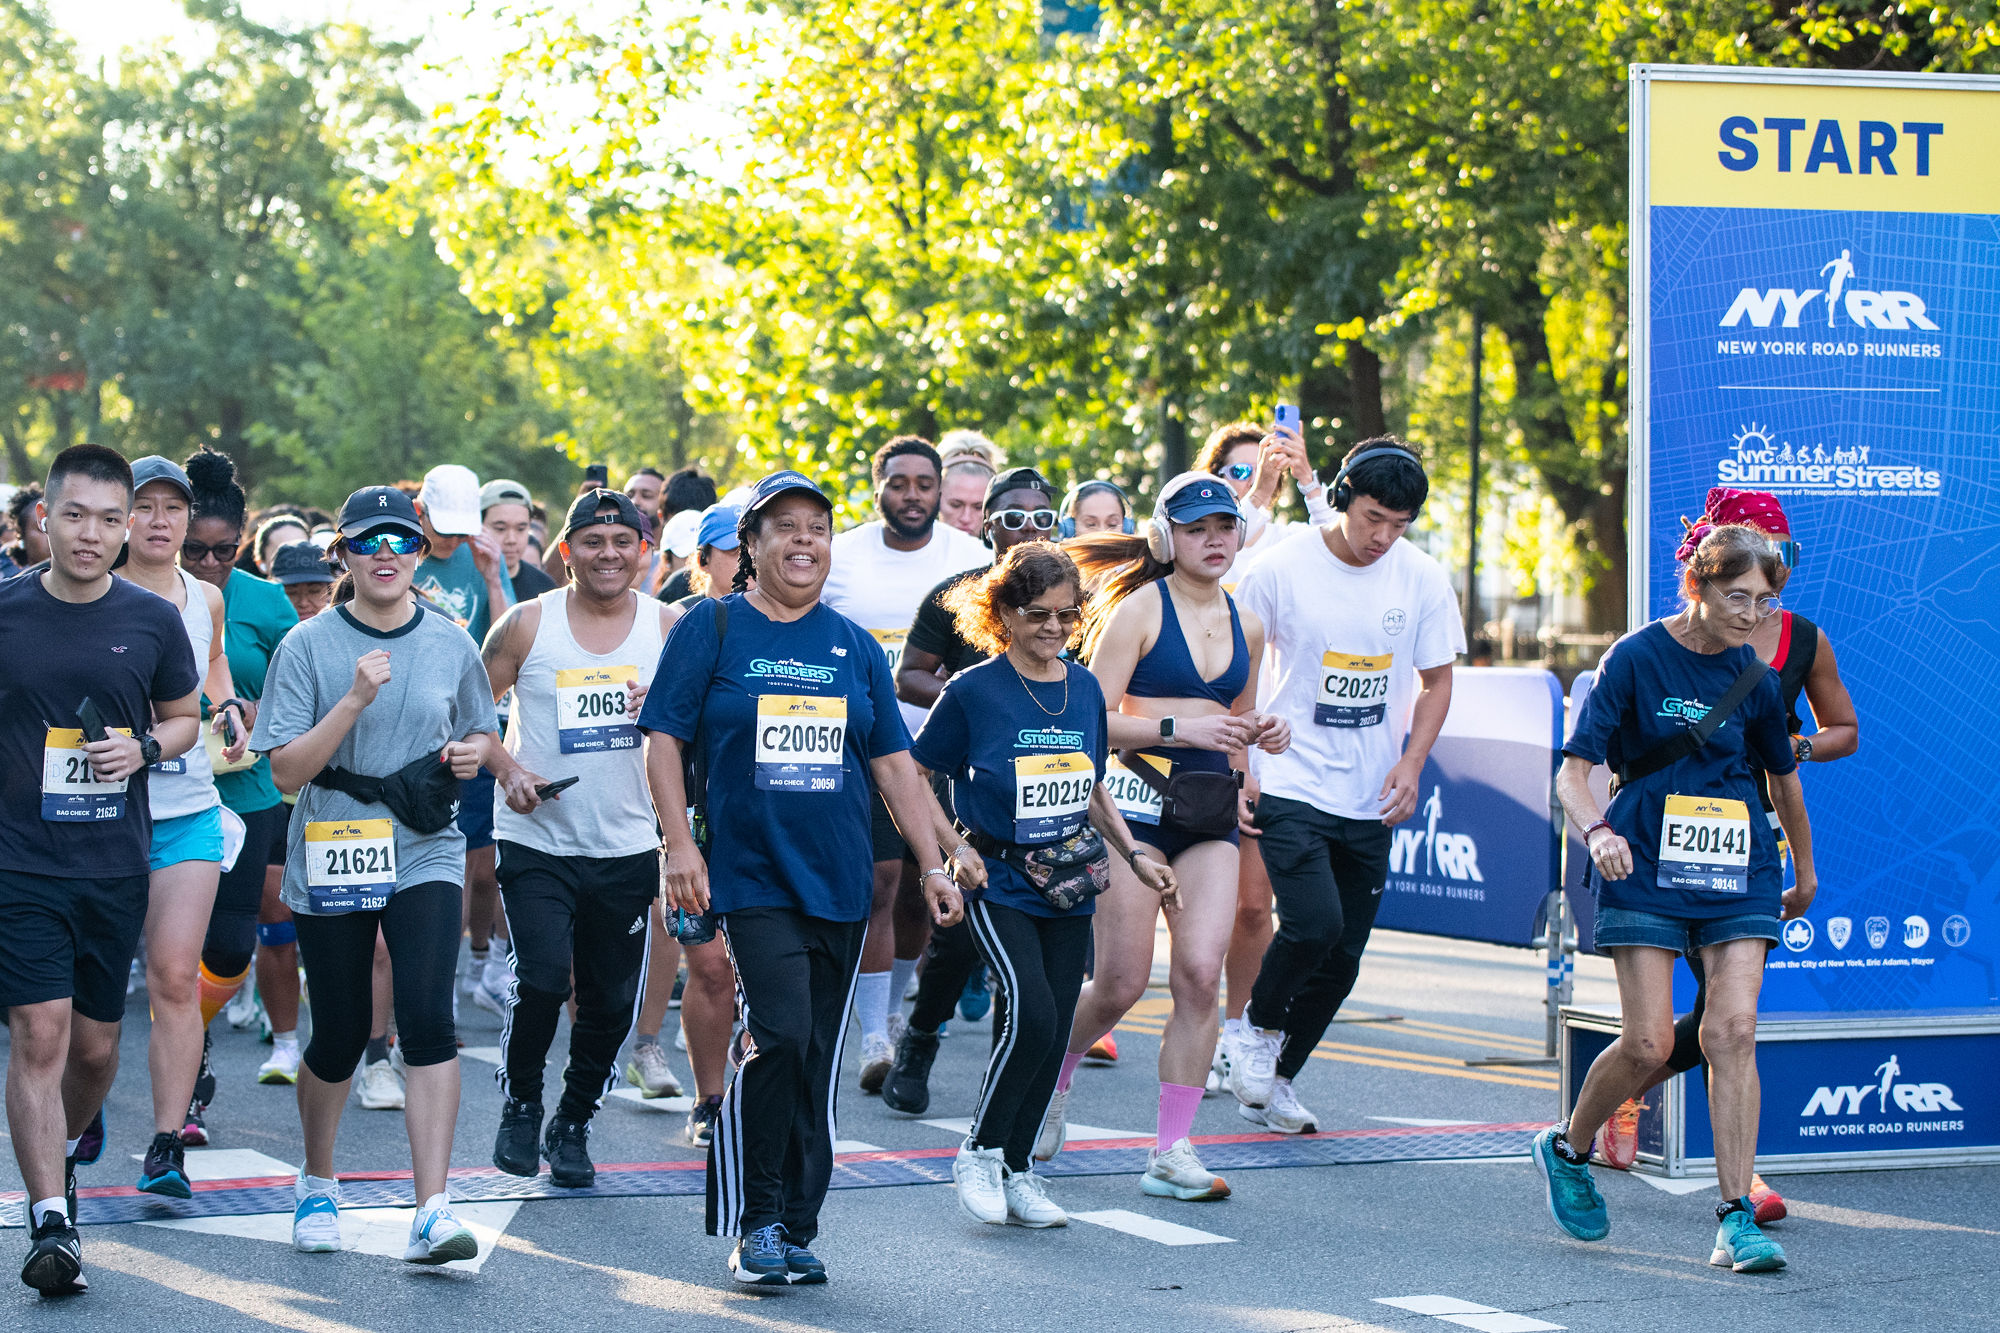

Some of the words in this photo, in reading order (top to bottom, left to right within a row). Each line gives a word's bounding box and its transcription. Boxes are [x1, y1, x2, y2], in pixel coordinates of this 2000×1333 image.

[1718, 116, 1943, 176] START
[1717, 341, 1757, 355] NEW
[1761, 341, 1806, 355] YORK
[1812, 342, 1858, 356] ROAD
[1864, 343, 1941, 357] RUNNERS
[1738, 450, 1774, 464] NYC
[1804, 488, 1857, 498] Transportation
[1859, 489, 1879, 498] Open
[1880, 489, 1908, 498] Streets
[757, 663, 827, 679] STRIDERS
[1324, 674, 1388, 699] C20273
[577, 691, 626, 718] 2063
[1359, 715, 1377, 726] 20273
[610, 736, 634, 748] 20633
[762, 724, 841, 753] C20050
[1024, 734, 1079, 745] STRIDERS
[161, 761, 180, 771] 21619
[811, 777, 835, 790] 20050
[1023, 778, 1092, 808] E20219
[96, 807, 117, 818] 21623
[1668, 823, 1746, 855] E20141
[326, 846, 392, 875] 21621
[1395, 881, 1416, 893] YORK
[1420, 883, 1442, 896] ROAD
[1446, 886, 1485, 902] RUNNERS
[1712, 877, 1738, 891] 20141
[361, 896, 387, 909] 21621
[1769, 960, 1786, 969] with
[1787, 960, 1800, 969] the
[1801, 960, 1816, 970] City
[1818, 959, 1827, 968] of
[1828, 960, 1844, 968] New
[1846, 959, 1865, 969] York,
[1866, 958, 1881, 967] Eric
[1882, 958, 1909, 967] Adams,
[1911, 958, 1935, 968] Mayor
[1800, 1126, 1828, 1136] NEW
[1831, 1124, 1864, 1135] YORK
[1868, 1122, 1903, 1134] ROAD
[1907, 1120, 1964, 1132] RUNNERS
